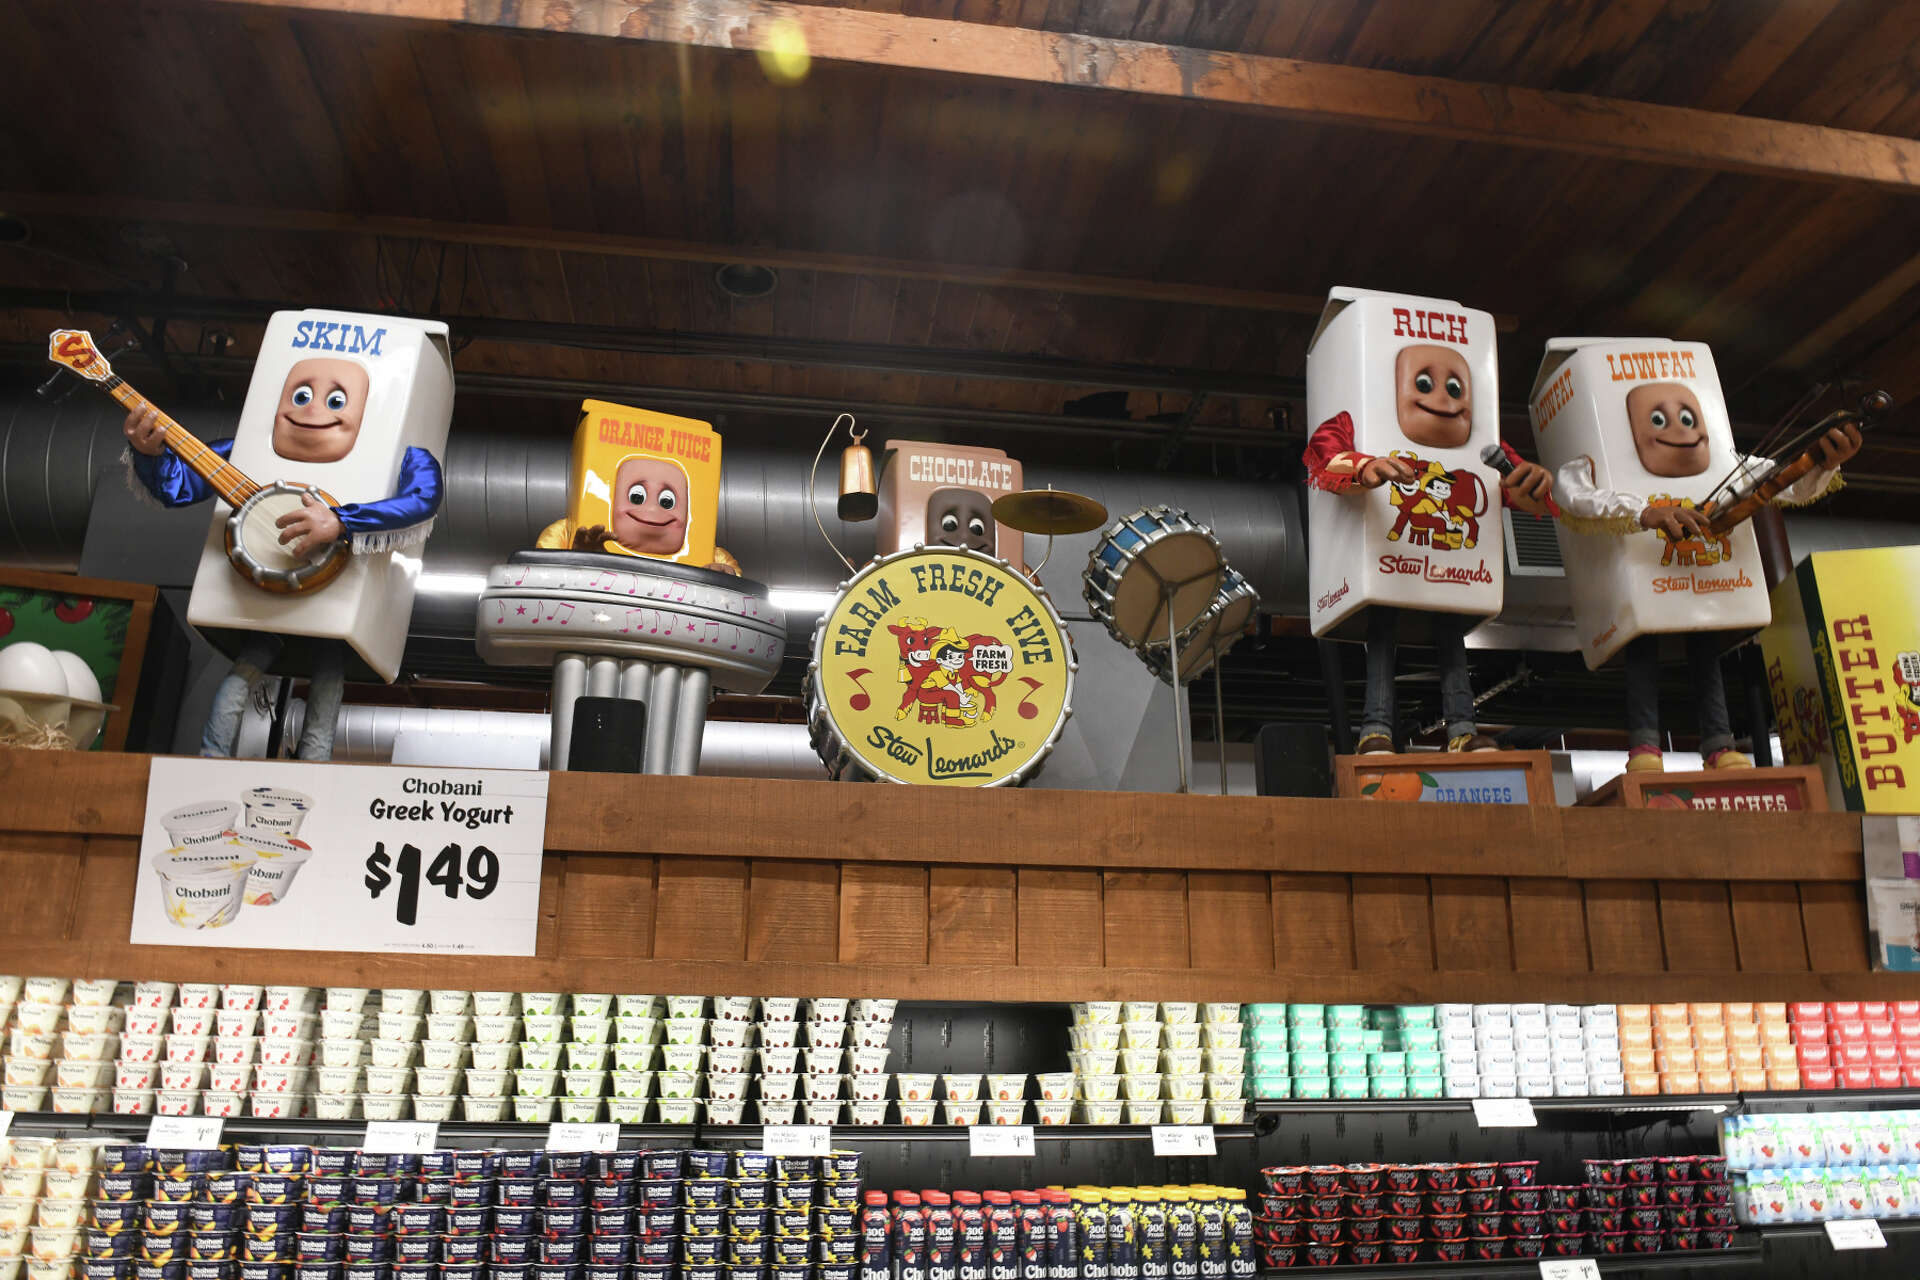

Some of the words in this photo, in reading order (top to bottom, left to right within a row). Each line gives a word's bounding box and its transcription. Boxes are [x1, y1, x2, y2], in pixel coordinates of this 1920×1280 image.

[291, 320, 387, 356] SKIM
[1393, 307, 1468, 345] RICH
[1606, 351, 1697, 382] LOWFAT
[1535, 367, 1575, 433] LOWFAT
[599, 417, 665, 452] ORANGE
[666, 428, 712, 463] JUICE
[910, 455, 1012, 491] CHOCOLATE
[1379, 555, 1423, 576] Stew
[834, 577, 902, 658] FARM
[910, 563, 1005, 607] FRESH
[1006, 604, 1054, 666] FIVE
[975, 660, 1008, 669] FRESH
[976, 649, 1006, 659] FARM
[1833, 614, 1906, 791] BUTTER
[867, 726, 923, 766] Stew
[926, 729, 1016, 780] Leonard's
[402, 778, 483, 796] Chobani
[1436, 787, 1512, 803] ORANGES
[255, 816, 292, 827] Chobani
[369, 798, 434, 821] Greek
[439, 801, 514, 830] Yogurt
[182, 831, 223, 845] Chobani
[249, 867, 284, 880] obani
[176, 884, 231, 899] Chobani
